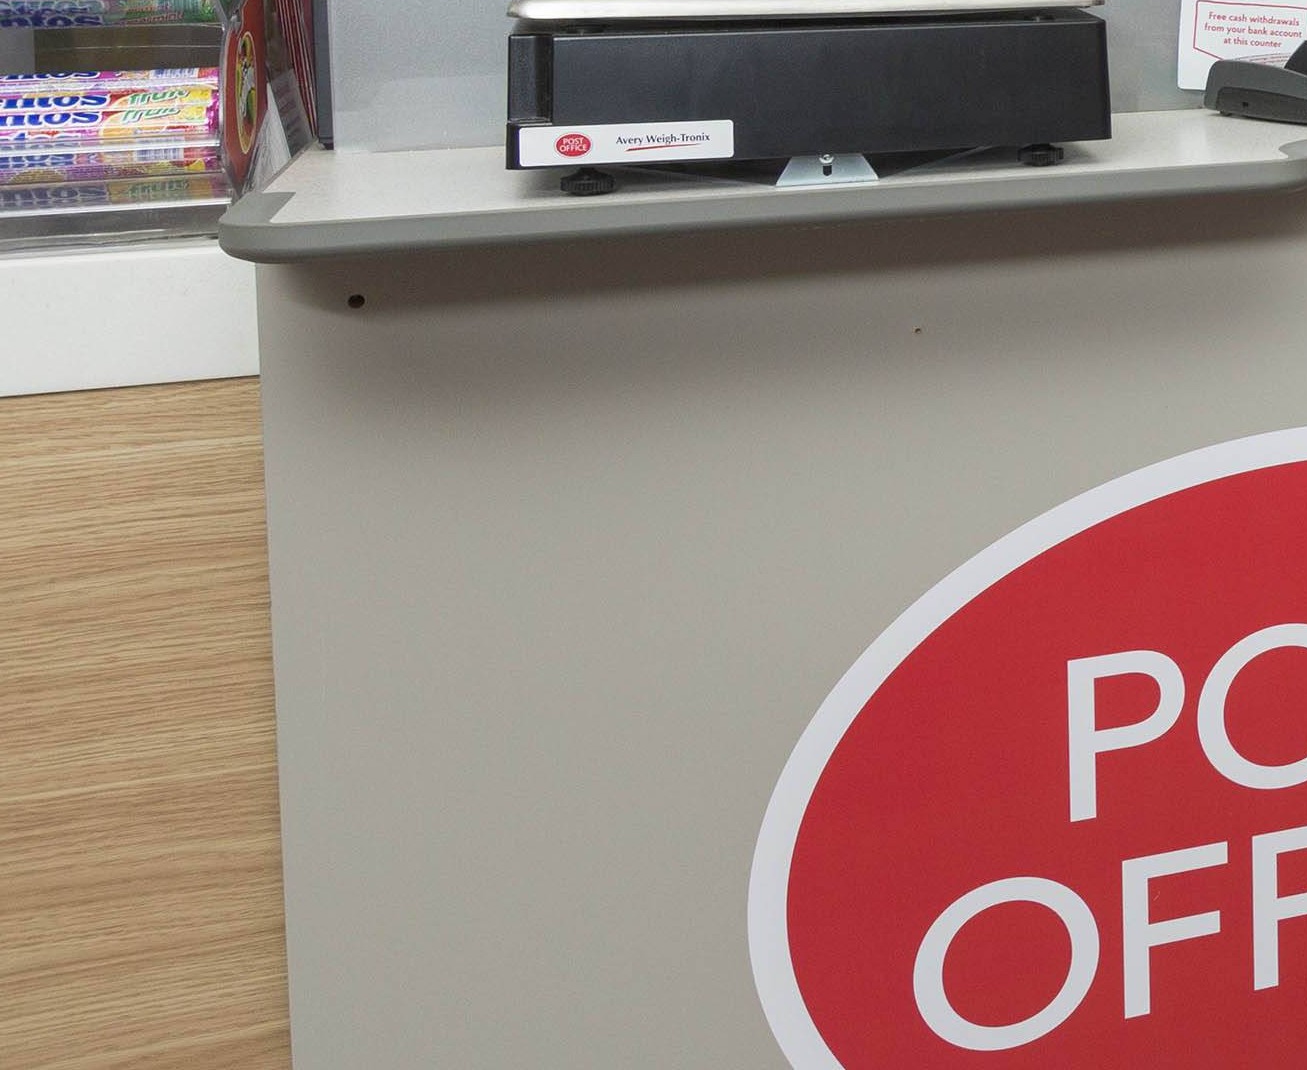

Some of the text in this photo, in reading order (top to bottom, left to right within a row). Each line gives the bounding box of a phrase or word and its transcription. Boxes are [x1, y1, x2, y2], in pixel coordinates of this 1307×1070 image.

[1209, 12, 1300, 26] Free cash withdrawals
[1204, 23, 1302, 38] from your bank account
[1234, 37, 1248, 46] this
[1250, 39, 1282, 49] counter
[562, 137, 585, 146] POST
[616, 132, 710, 147] Avery Weigh-Tronix
[559, 143, 588, 153] OFFICE
